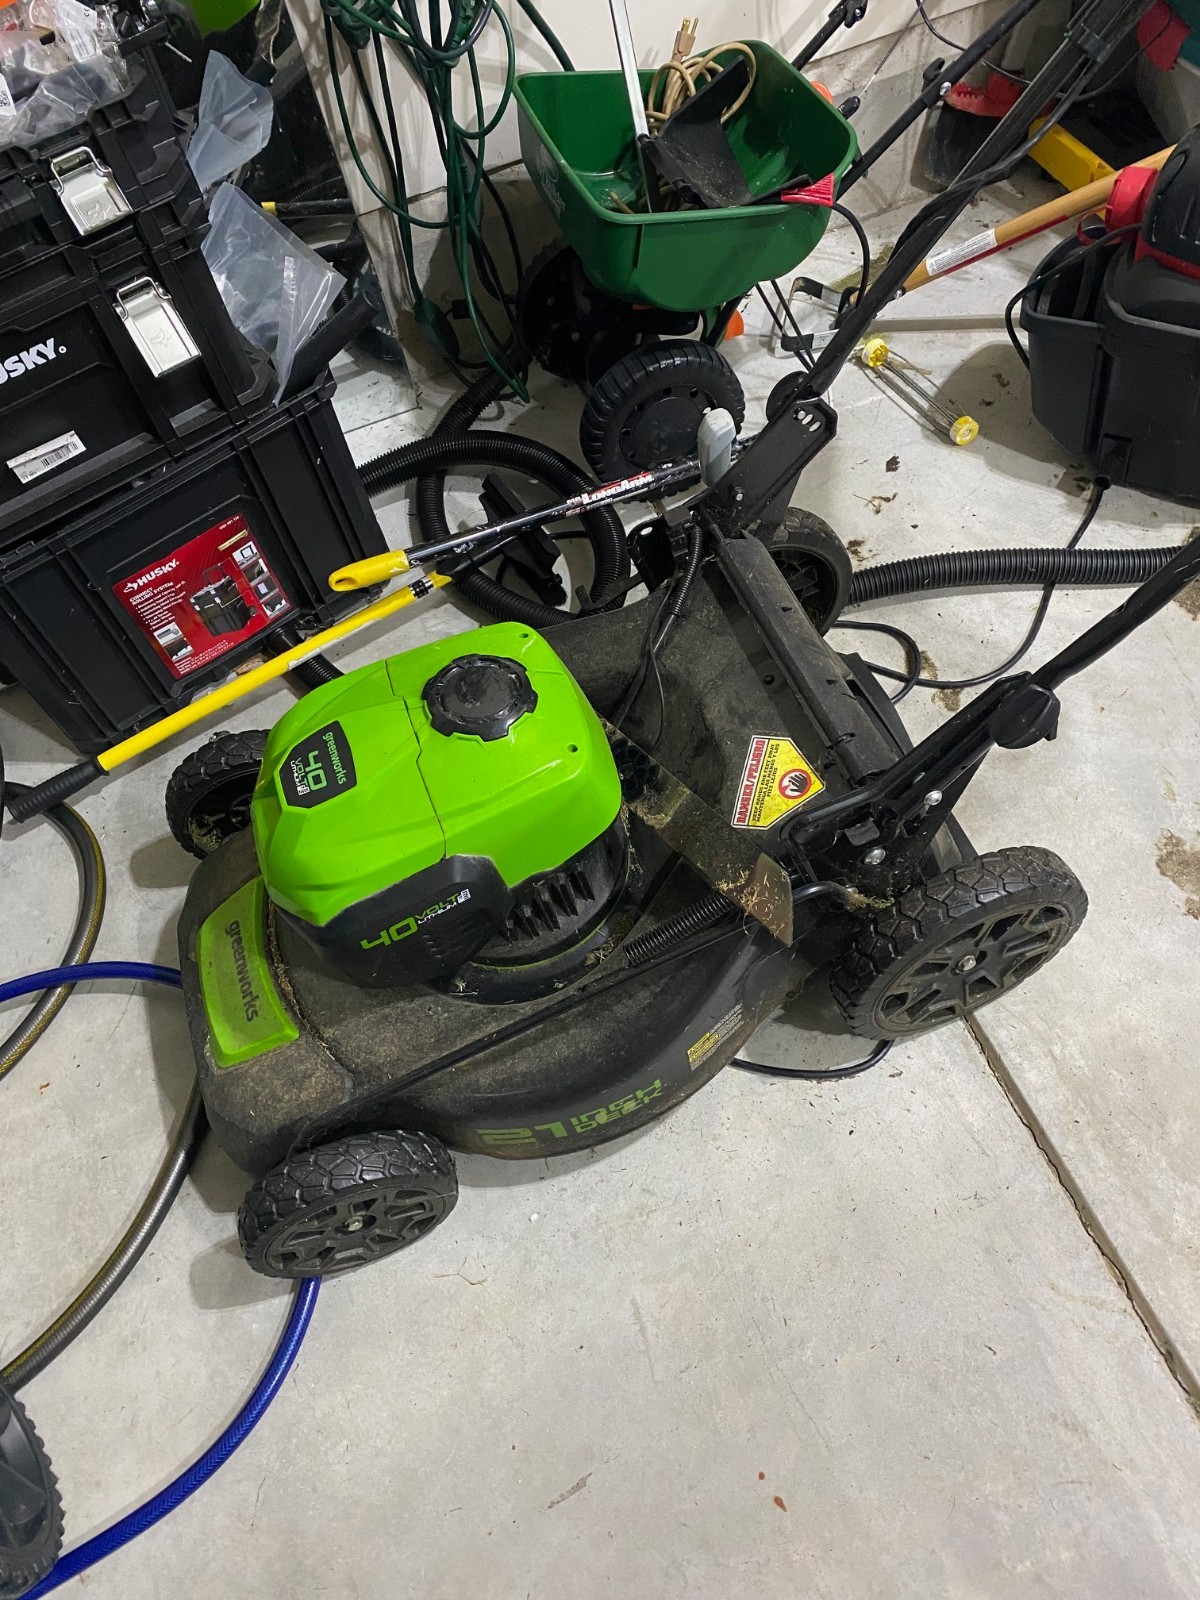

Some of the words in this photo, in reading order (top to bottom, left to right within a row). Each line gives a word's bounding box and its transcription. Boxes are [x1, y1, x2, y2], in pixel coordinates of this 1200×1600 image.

[136, 558, 177, 586] HUSKY
[153, 582, 174, 594] SYSTEM
[295, 757, 308, 786] VOLT
[305, 750, 327, 791] 40
[322, 731, 347, 785] greenworks
[290, 760, 301, 787] LITHIUM
[360, 916, 418, 949] 40
[415, 893, 459, 919] VOLT
[417, 902, 458, 924] LITHIUM
[225, 920, 259, 1022] greenworks
[475, 1121, 568, 1145] 21
